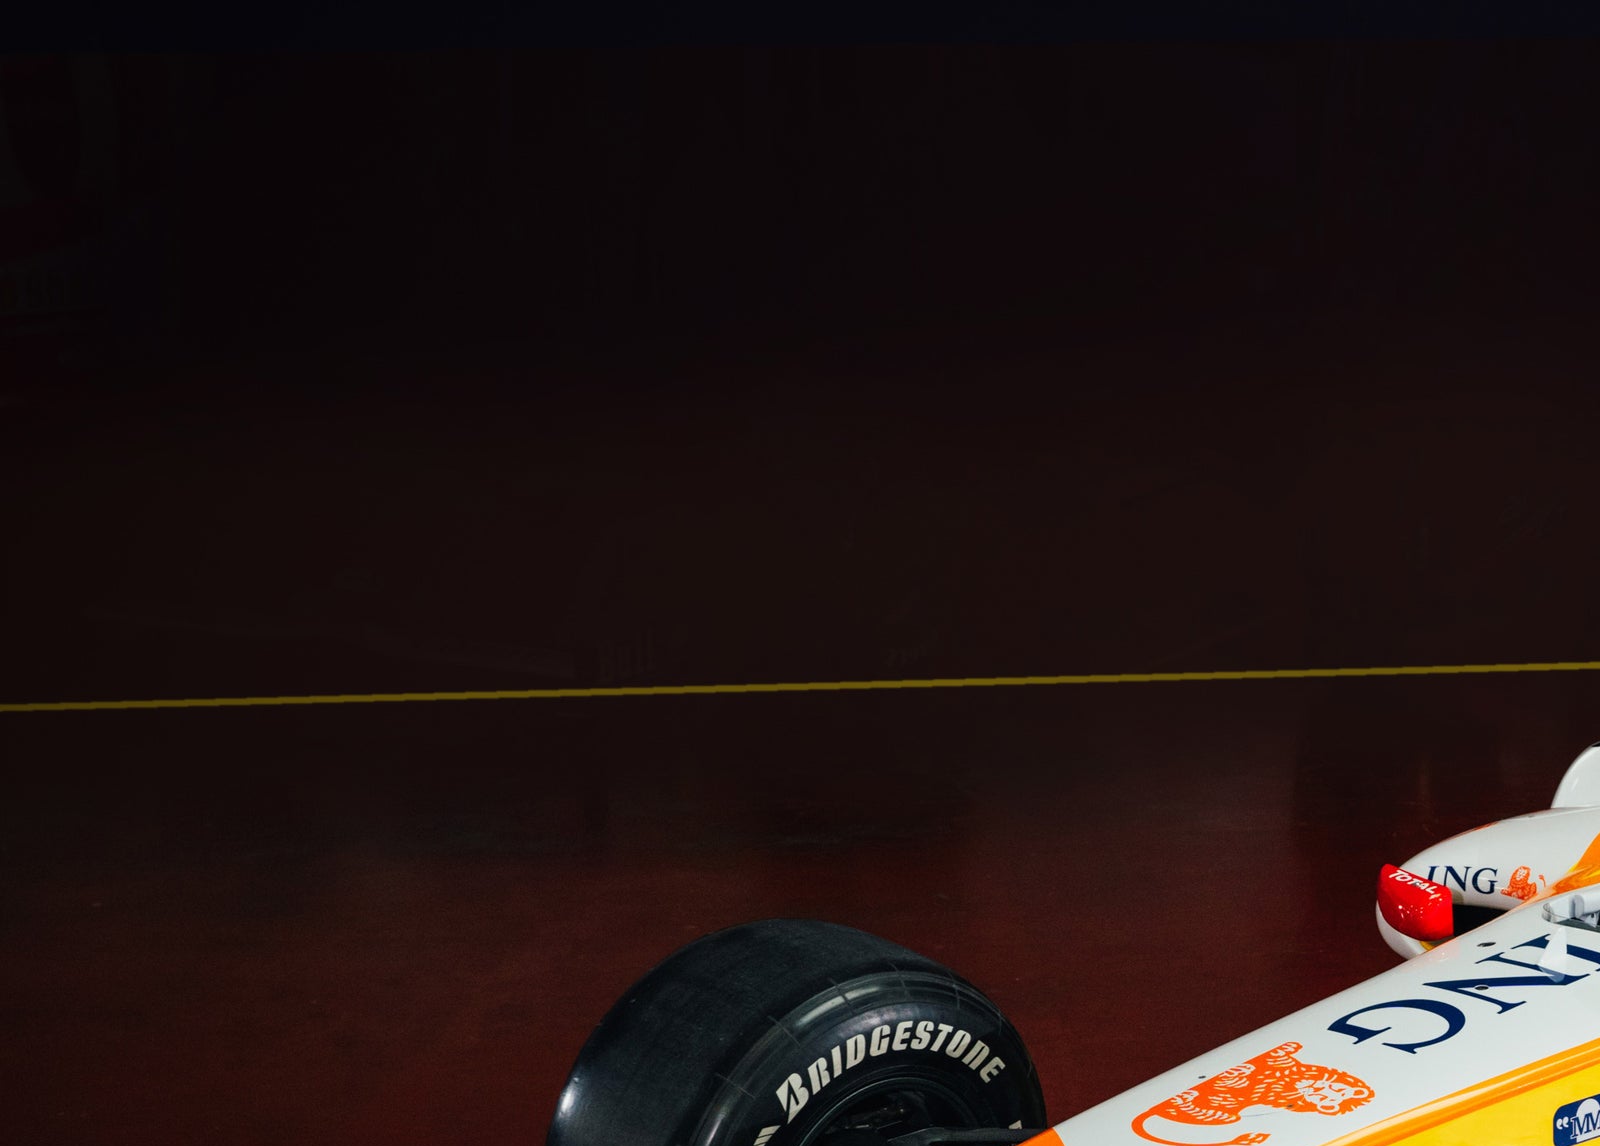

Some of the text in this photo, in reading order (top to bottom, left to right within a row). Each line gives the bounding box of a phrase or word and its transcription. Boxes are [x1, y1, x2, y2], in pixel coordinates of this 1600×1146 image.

[1388, 869, 1437, 894] TOTAL
[1427, 865, 1498, 895] ING
[776, 1020, 1005, 1124] BRIDGESTONE
